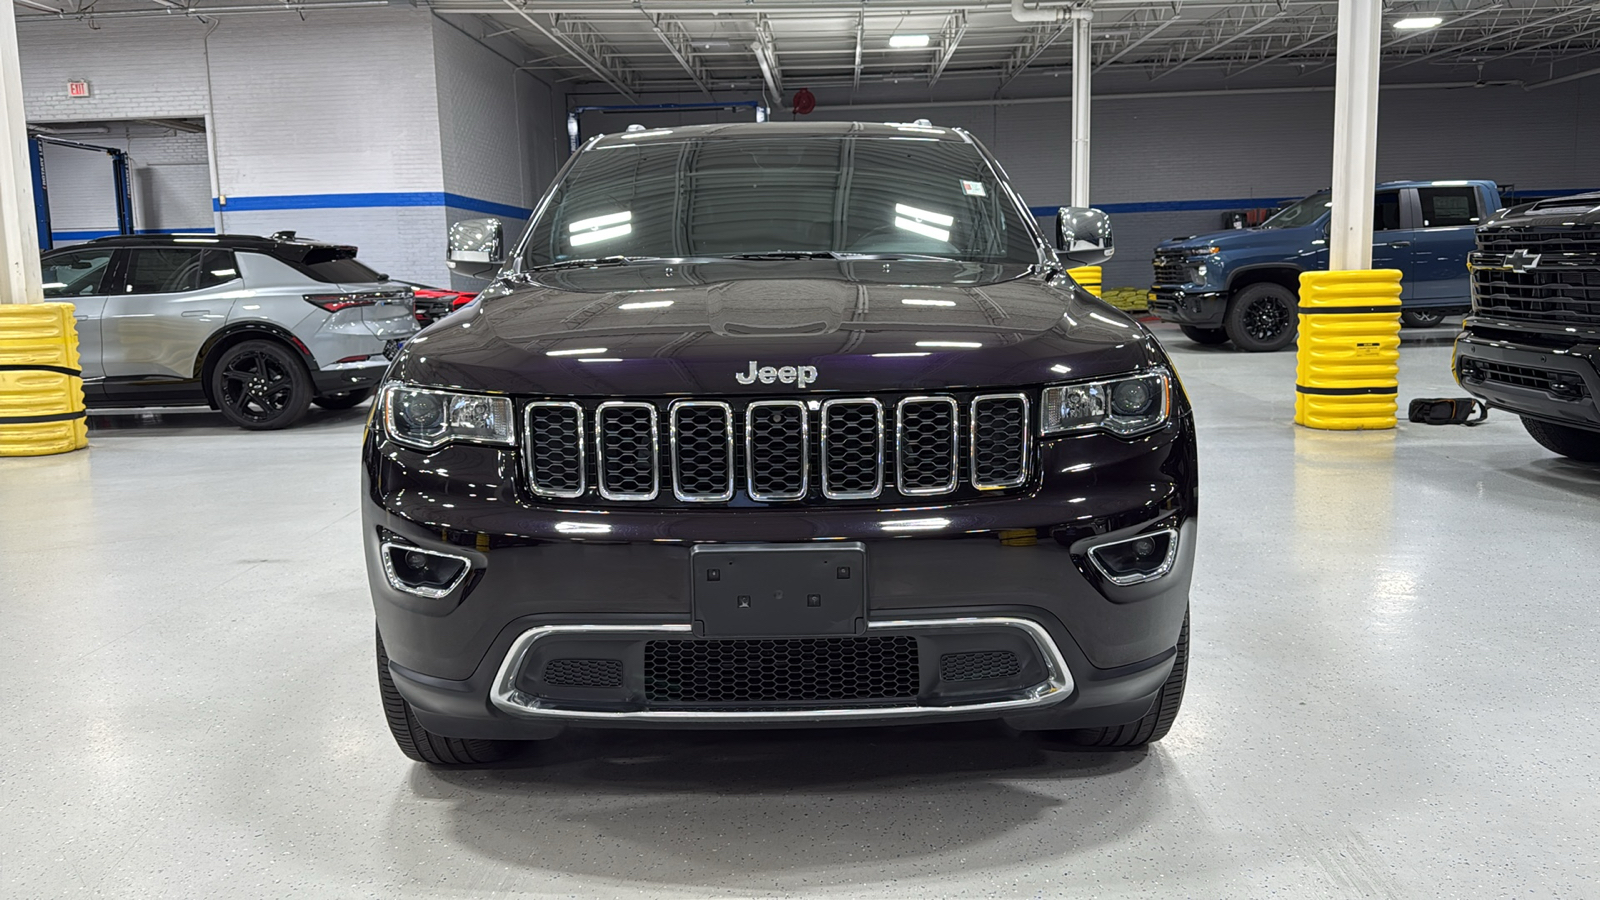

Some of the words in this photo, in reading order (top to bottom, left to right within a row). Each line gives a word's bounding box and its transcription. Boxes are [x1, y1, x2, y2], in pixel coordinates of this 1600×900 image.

[70, 83, 85, 95] EXIT
[39, 157, 47, 186] ROTARY
[735, 360, 818, 389] Jeep
